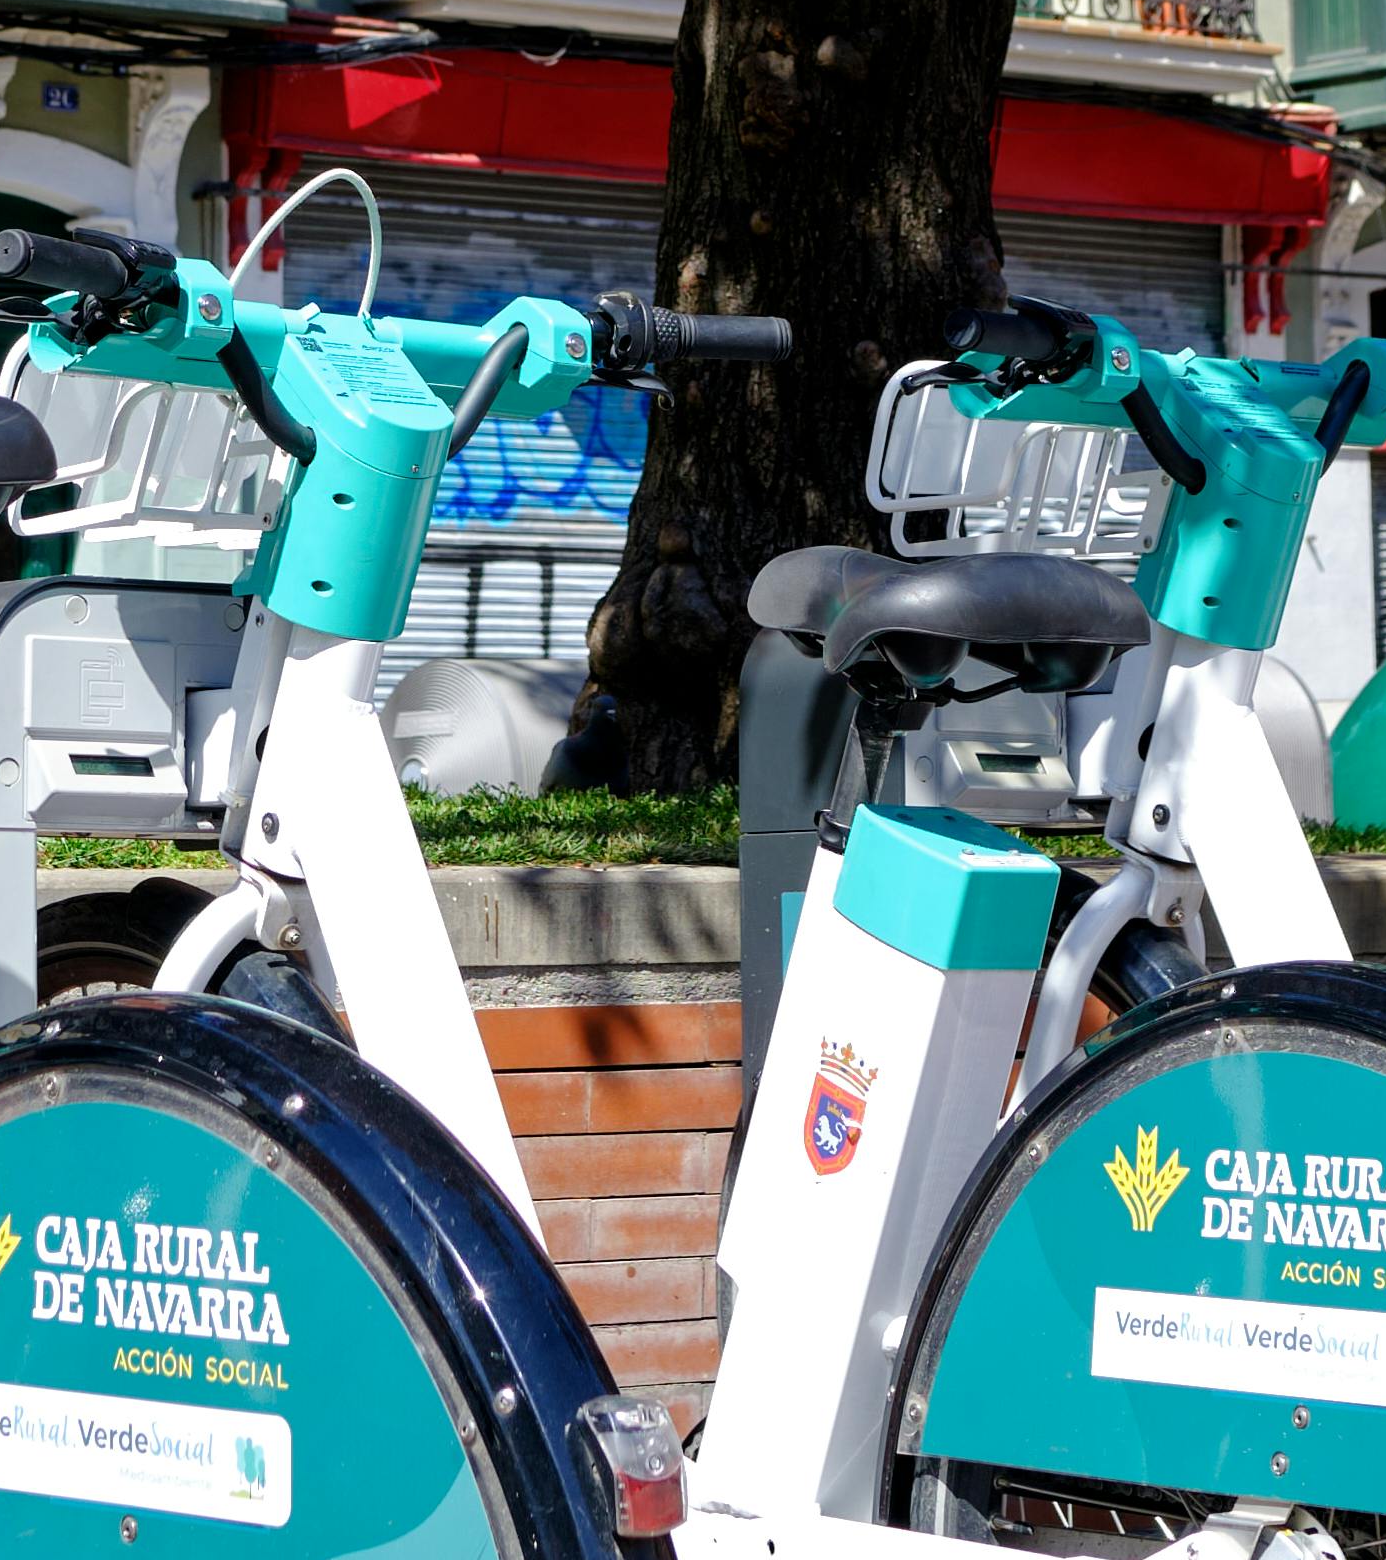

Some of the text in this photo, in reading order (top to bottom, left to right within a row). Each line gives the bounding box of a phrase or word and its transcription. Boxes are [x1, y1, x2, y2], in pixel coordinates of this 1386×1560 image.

[1205, 1149, 1297, 1197] CAJA
[1201, 1196, 1254, 1241] DE
[36, 1215, 270, 1284] CAJA RURAL
[1280, 1260, 1361, 1287] ACCIÓN
[32, 1270, 290, 1345] DE NAVARRA
[113, 1346, 289, 1389] ACCIÓN SOCIAL
